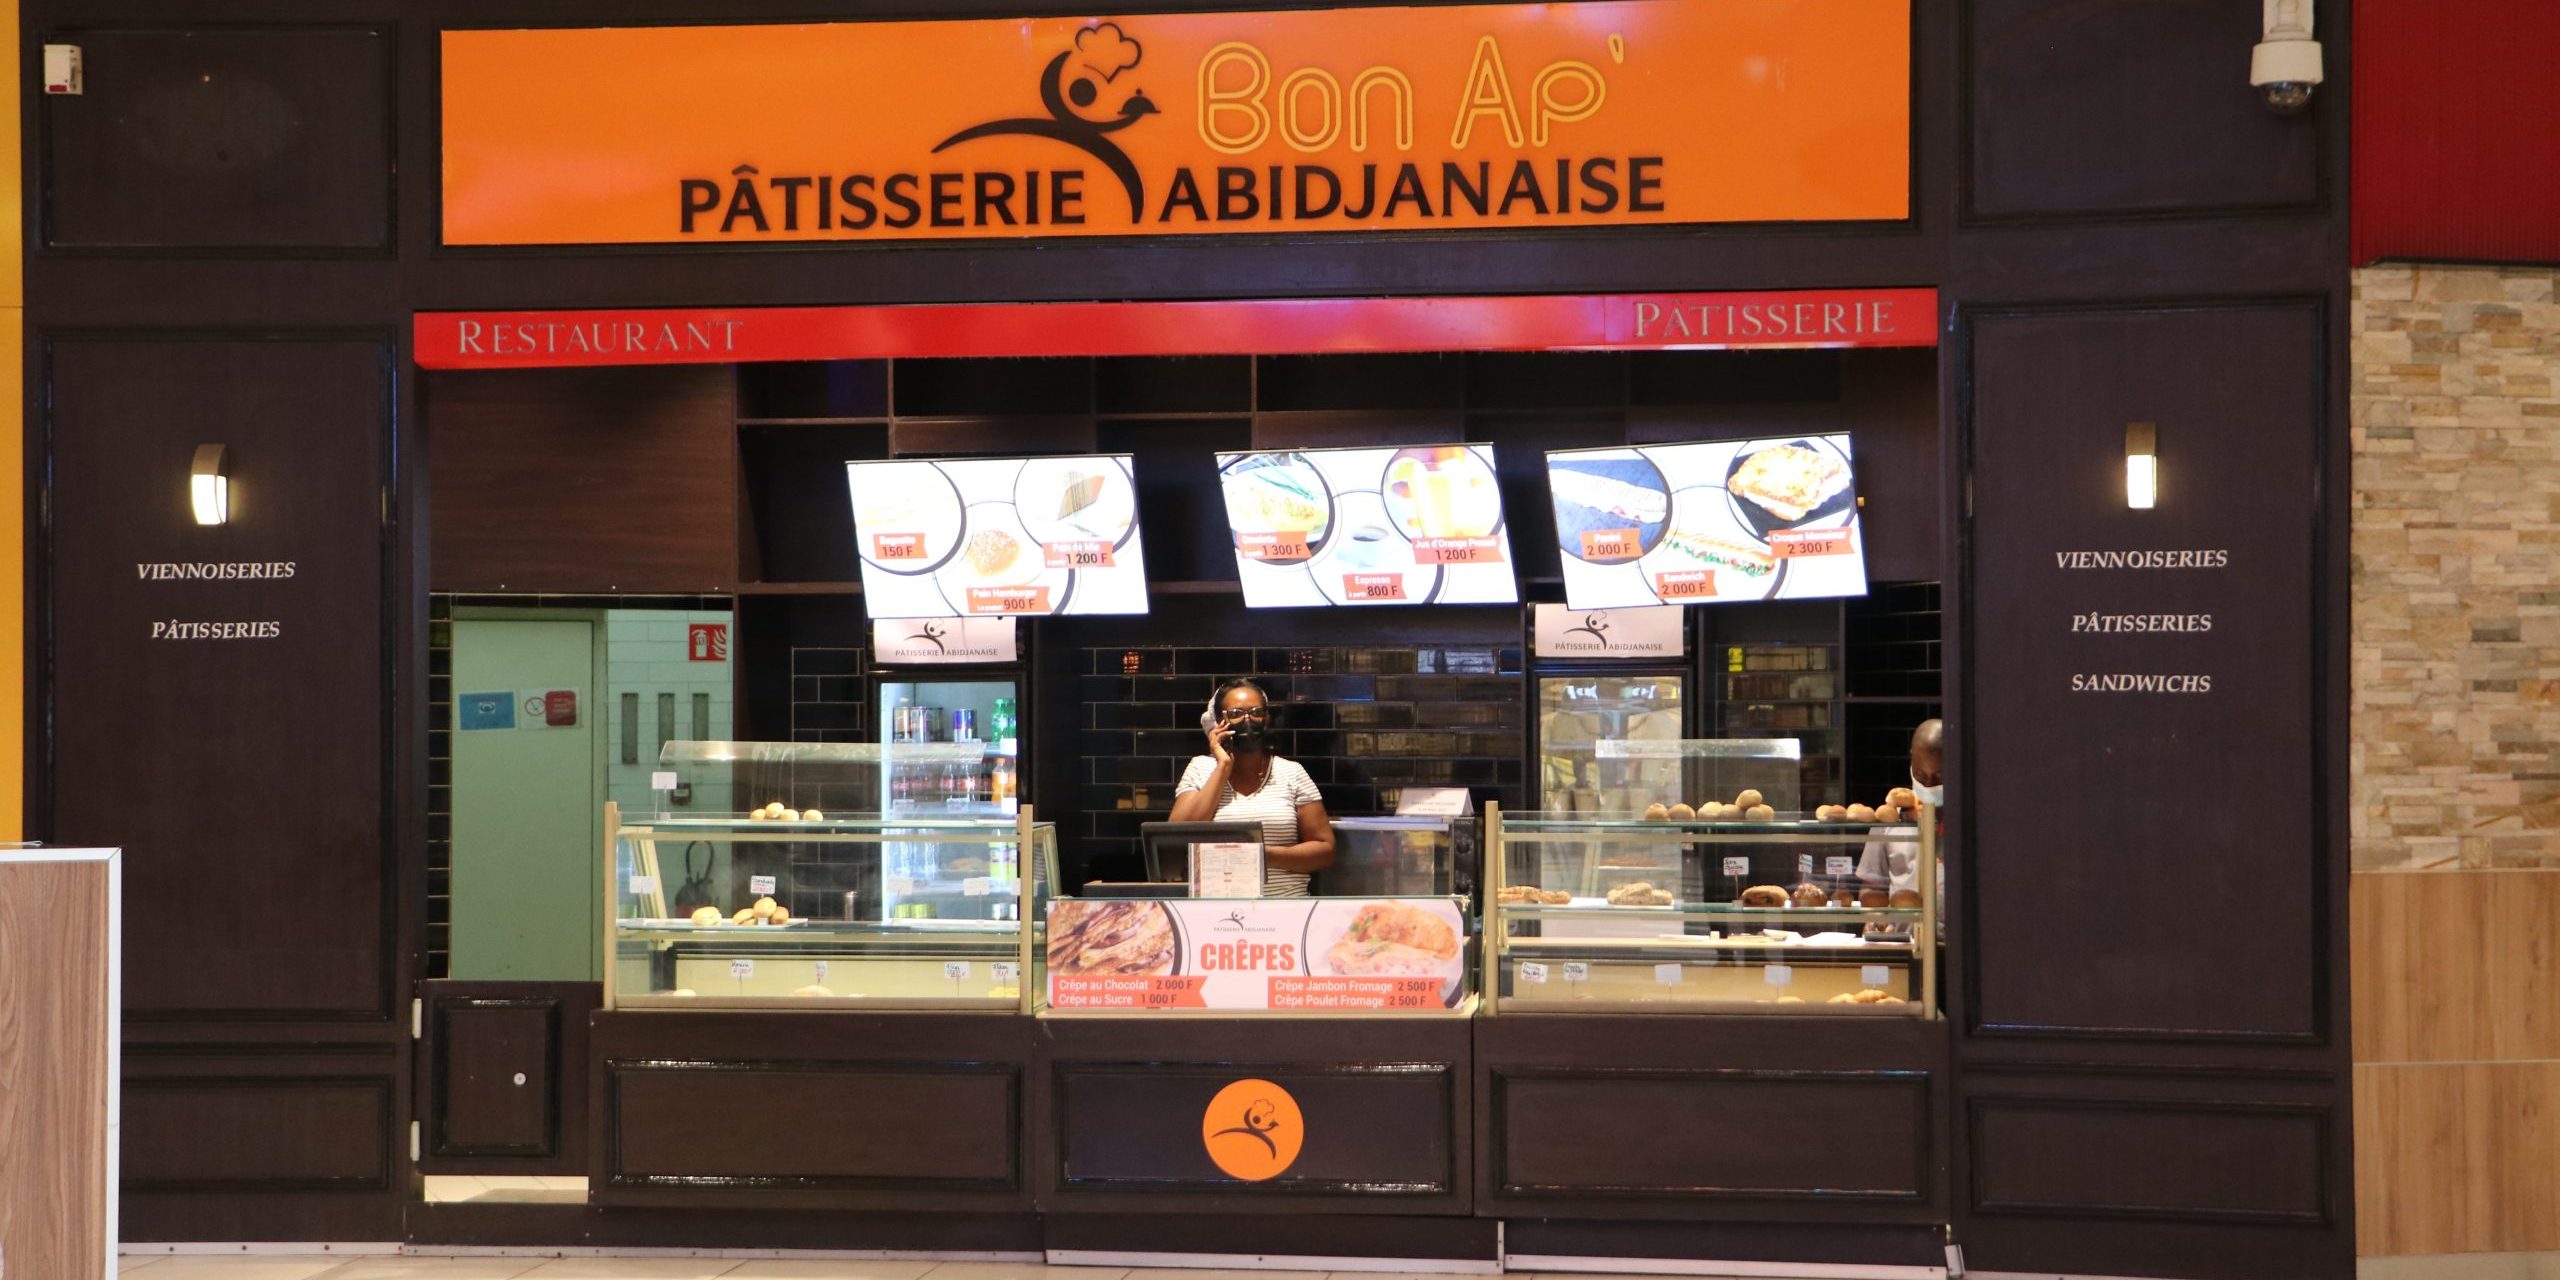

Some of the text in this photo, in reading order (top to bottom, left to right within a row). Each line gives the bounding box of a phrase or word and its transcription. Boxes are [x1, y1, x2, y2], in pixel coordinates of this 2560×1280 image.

[1198, 33, 1625, 154] Bon Ap'
[680, 157, 1664, 233] PÂTISSERIE ABIDJANAISE
[882, 546, 913, 557] 150 F
[1271, 545, 1292, 555] 300
[1295, 544, 1301, 555] F
[1587, 543, 1631, 555] 2 000 F
[1788, 541, 1833, 554] 2 300 F
[1066, 554, 1071, 564] 1
[1076, 553, 1098, 564] 200
[1101, 553, 1107, 563] F
[1435, 549, 1476, 560] 1 200 F
[2056, 550, 2228, 569] VIENNOISERIES
[137, 561, 296, 580] VIENNOISERIES
[972, 589, 991, 598] Pain
[1367, 586, 1388, 596] 800
[1391, 585, 1398, 595] F
[1662, 582, 1706, 595] 2 000 F
[1004, 599, 1025, 610] 900
[1029, 598, 1036, 609] F
[2071, 611, 2212, 632] PÂTISSERIES
[151, 619, 280, 639] PÂTISSERIES
[2071, 673, 2211, 693] SANDWICHS
[1200, 938, 1295, 970] CRÊPES
[1059, 979, 1193, 992] Crêpe au Chocolat 2 000 F
[1275, 979, 1435, 993] Crêpe Jambon Fromage 2 500 F
[1059, 993, 1177, 1006] Crêpe au Sucre 1 000 F
[1275, 994, 1426, 1008] Crêpe Poulet Fromage 2 500 F
